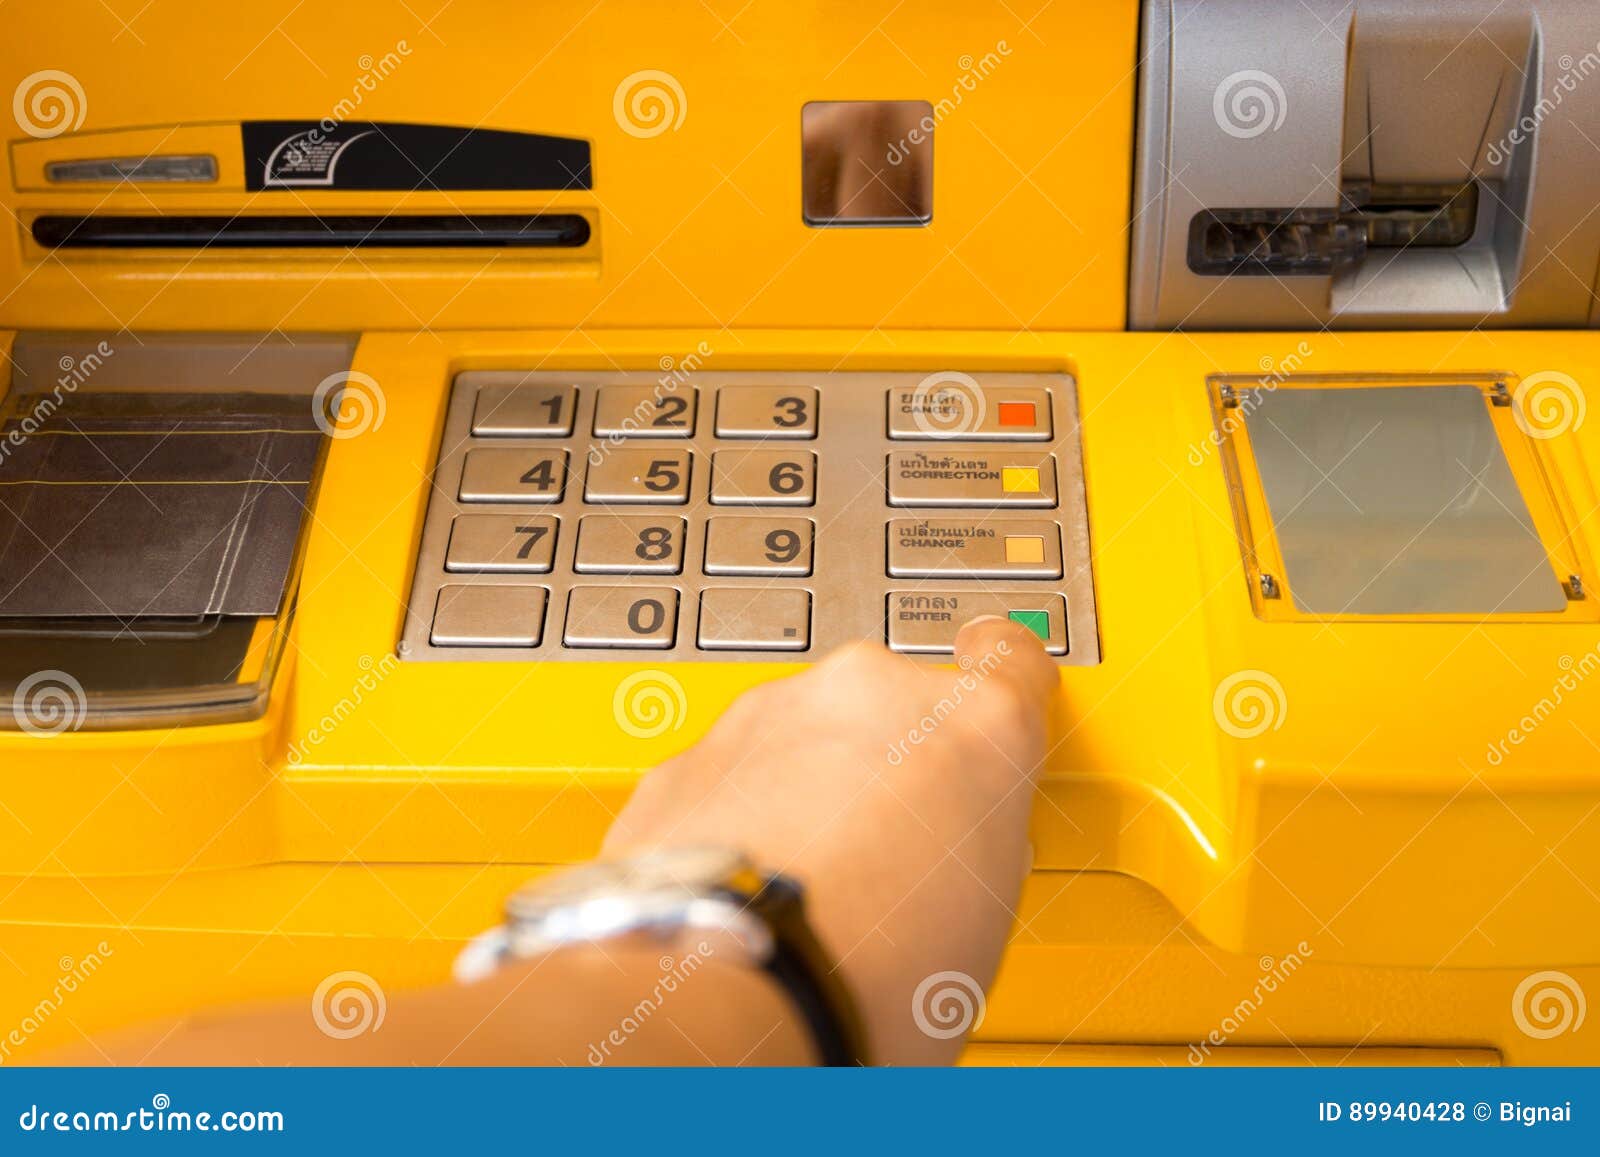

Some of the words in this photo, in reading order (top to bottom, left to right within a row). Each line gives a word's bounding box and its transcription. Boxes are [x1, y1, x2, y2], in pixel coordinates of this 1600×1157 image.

[540, 395, 562, 425] 1
[652, 396, 688, 427] 2
[773, 397, 808, 427] 3
[519, 460, 556, 491] 4
[644, 460, 680, 492] 5
[900, 453, 988, 469] แก้ไขตัวเลข
[900, 470, 1000, 480] CORRECTION
[768, 462, 804, 494] 6
[514, 526, 549, 559] 7
[635, 527, 673, 561] 8
[900, 521, 995, 537] เปลี่ยนแปลง
[900, 538, 965, 548] CHANGE
[765, 529, 801, 563] 9
[627, 598, 665, 634] 0
[899, 596, 958, 609] ตกลง
[899, 611, 952, 621] ENTER
